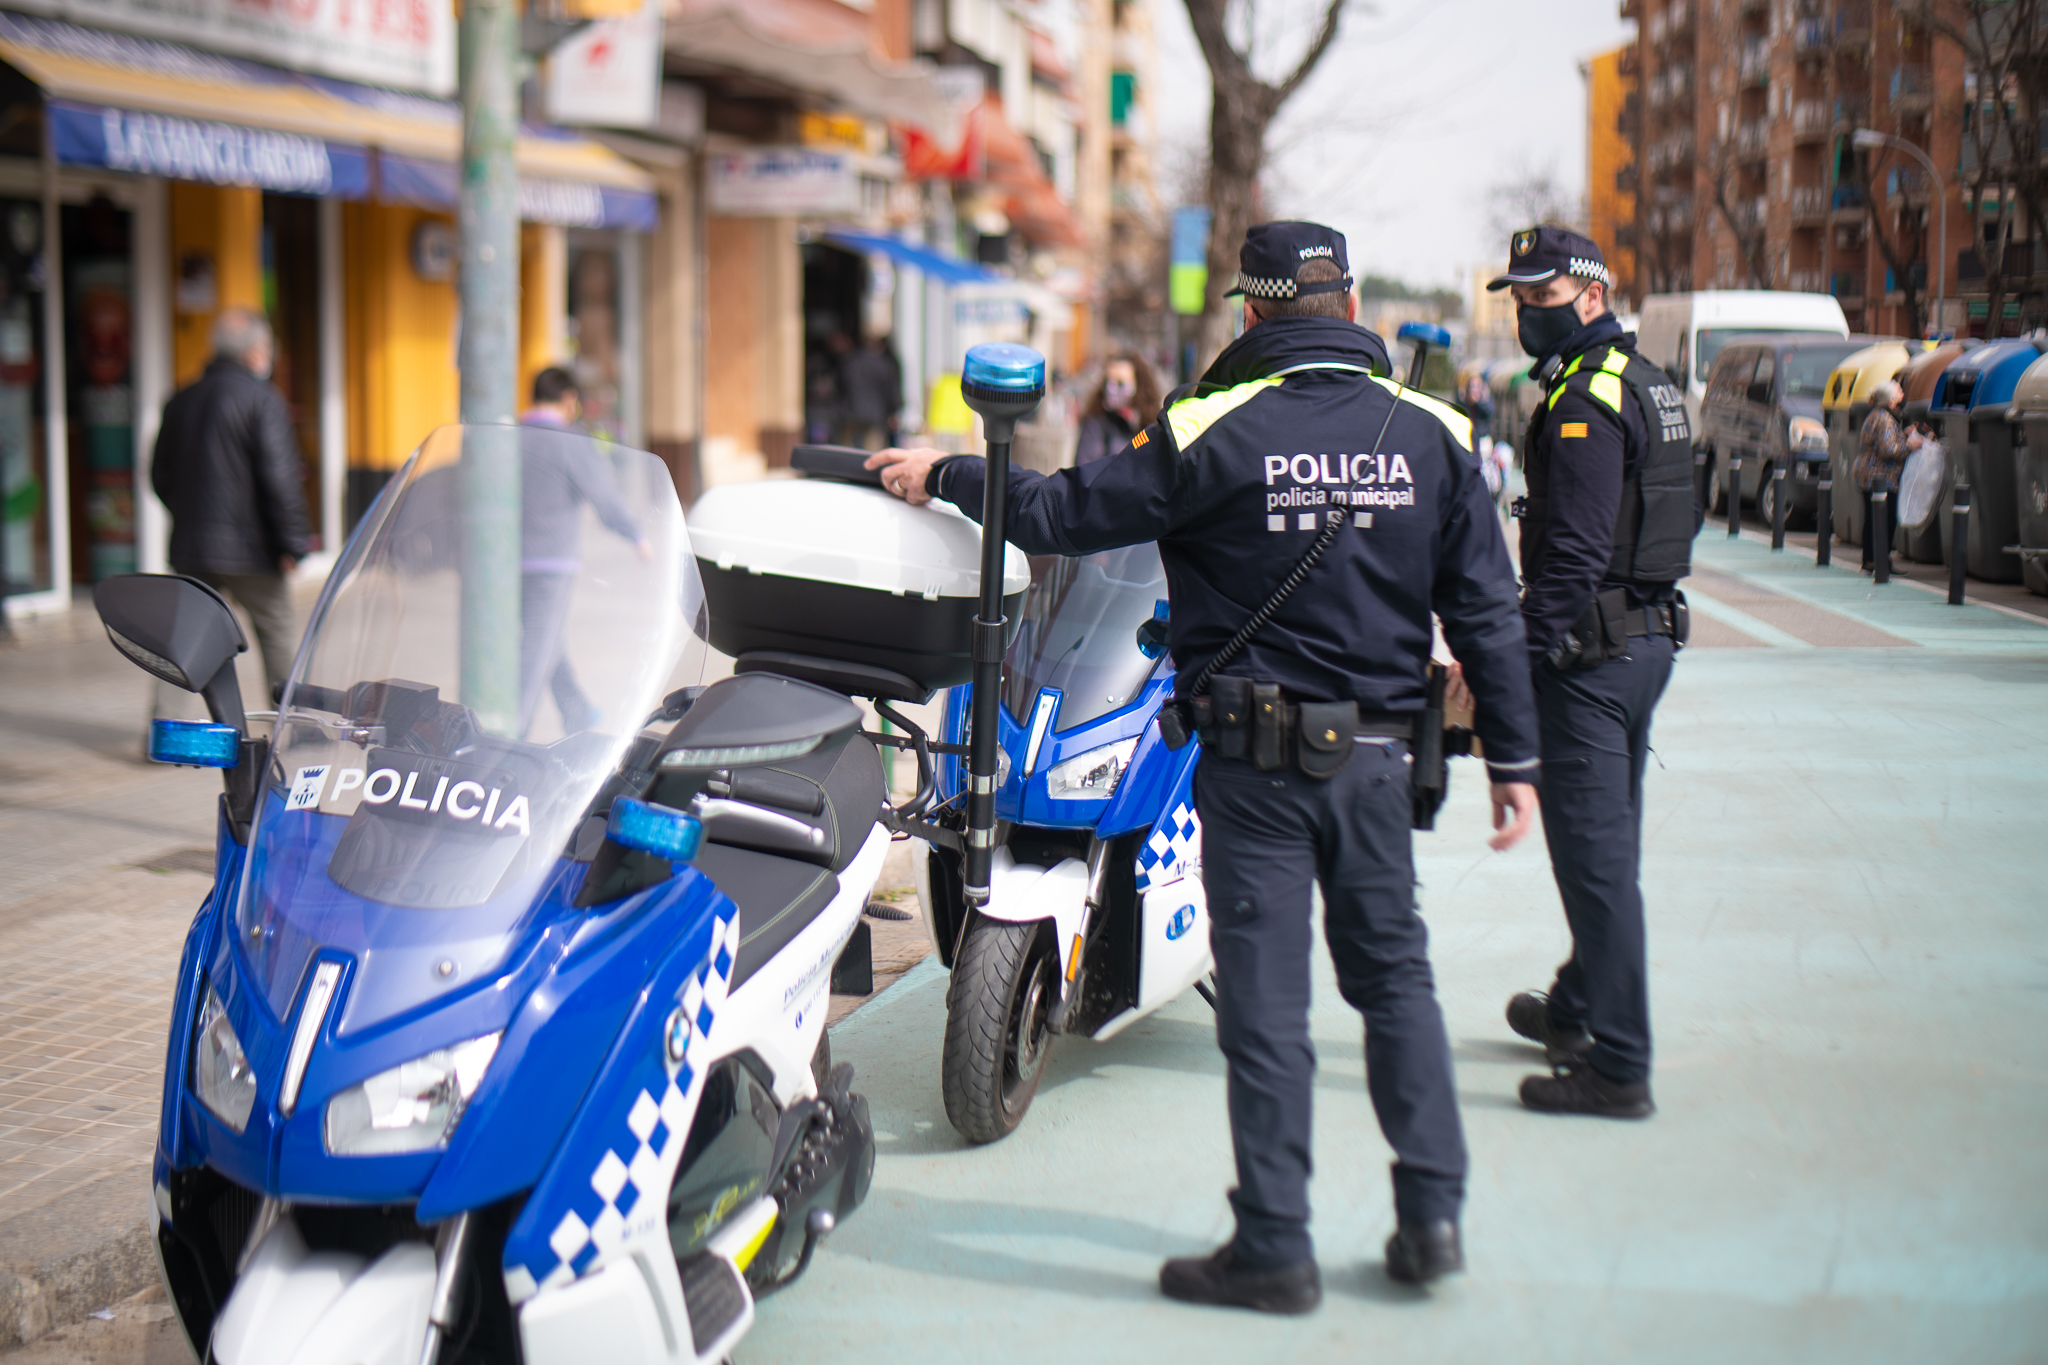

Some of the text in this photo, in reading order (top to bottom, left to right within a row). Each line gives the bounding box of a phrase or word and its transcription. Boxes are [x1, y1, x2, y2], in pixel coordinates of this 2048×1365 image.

[1299, 245, 1333, 260] POLICIA
[1264, 453, 1414, 485] POLICIA
[1267, 486, 1415, 512] policia municipal
[330, 768, 531, 836] POLICIA
